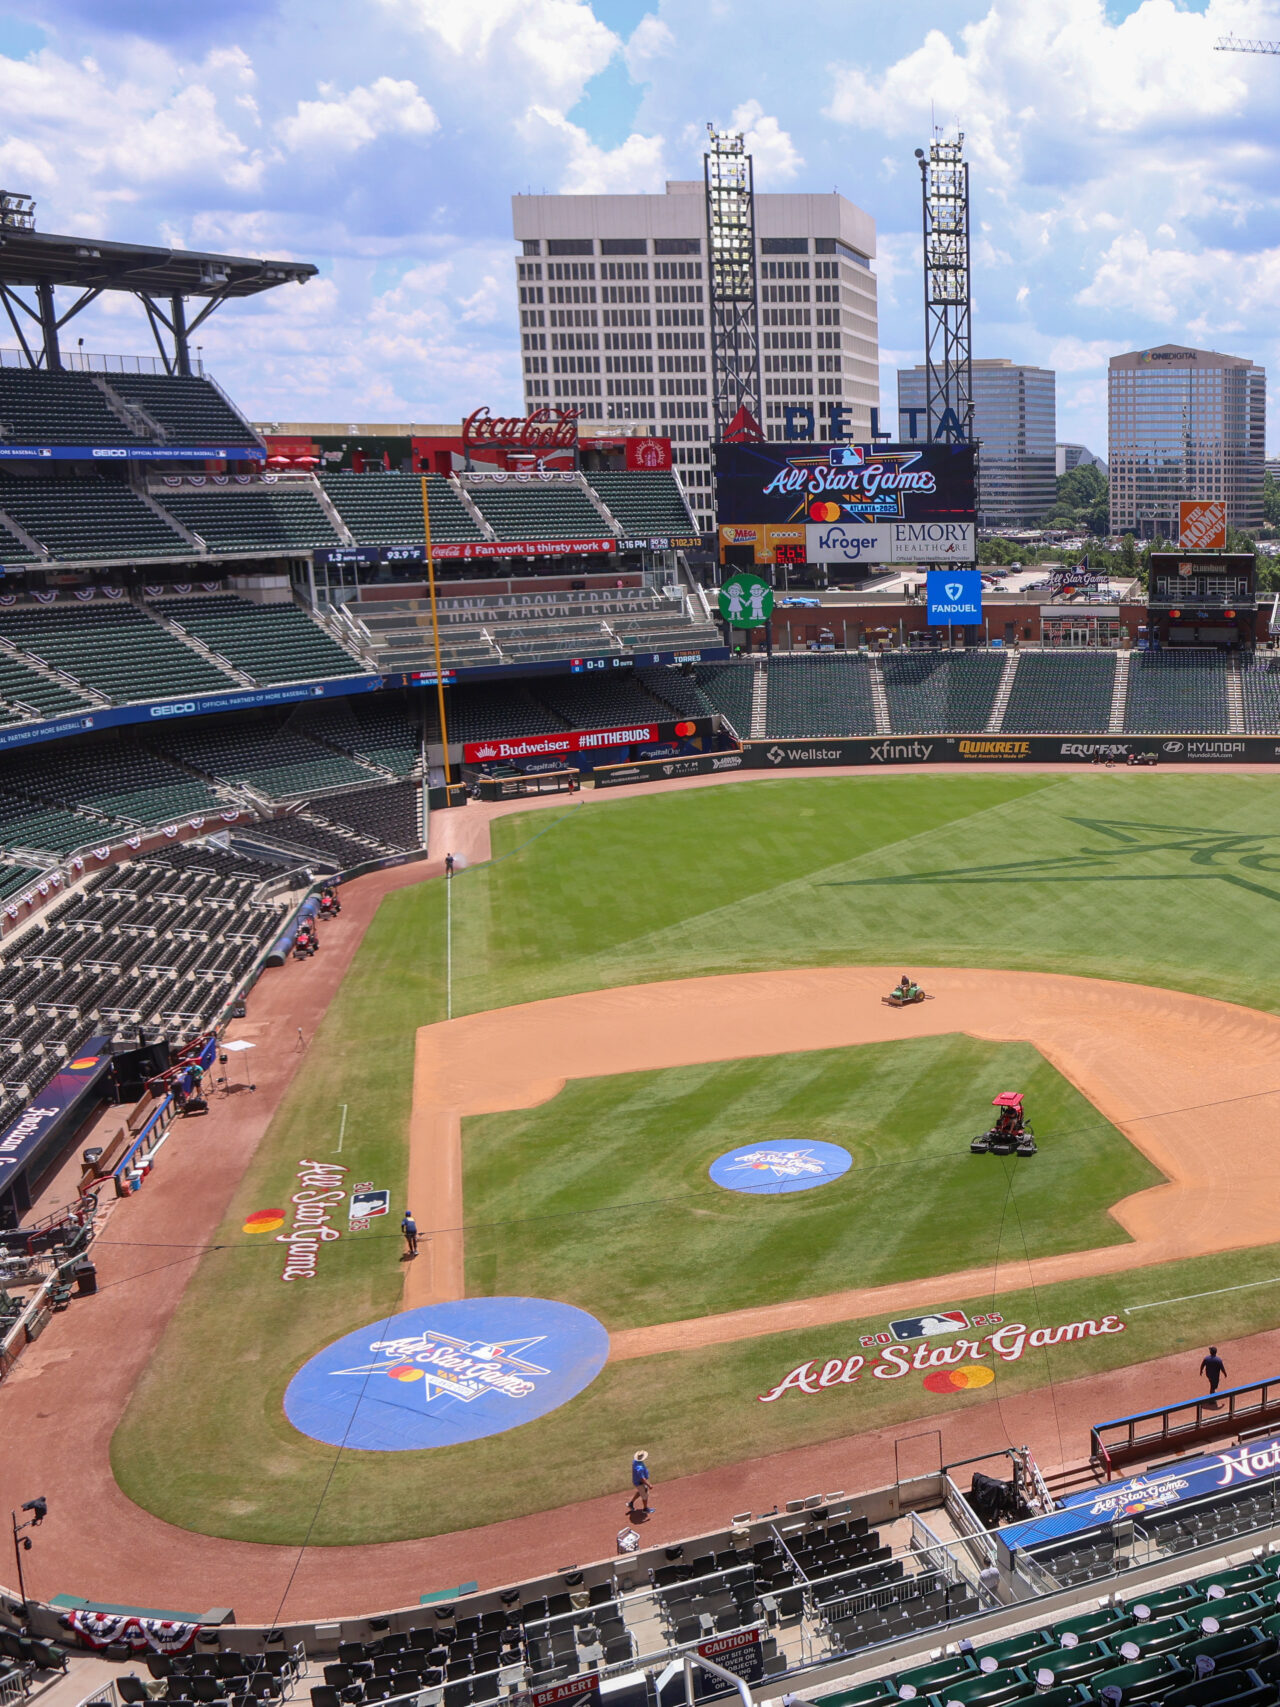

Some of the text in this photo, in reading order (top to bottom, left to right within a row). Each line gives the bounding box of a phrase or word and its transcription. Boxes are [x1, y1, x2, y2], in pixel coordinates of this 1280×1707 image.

[785, 407, 966, 439] DELTA
[763, 465, 936, 497] All Star Game
[850, 504, 897, 513] ATLANTA 2025
[1184, 507, 1203, 525] THE
[1180, 502, 1225, 548] HOME
[896, 524, 970, 541] EMORY
[1197, 520, 1225, 548] DEPOT
[475, 547, 496, 555] Fan
[497, 546, 525, 554] work
[527, 544, 535, 552] is
[537, 543, 571, 553] thirsty
[618, 540, 633, 549] 1:16
[634, 540, 647, 548] PM
[670, 539, 702, 547] $102,313
[819, 527, 878, 559] Kroger
[896, 543, 967, 552] HEALTHCARE
[387, 551, 409, 559] 93.9
[777, 545, 806, 558] 264
[1044, 572, 1109, 584] All Star Game
[438, 590, 660, 623] HANK AARON TERRACE
[932, 604, 977, 613] FANDUEL
[674, 655, 701, 663] TORRES
[151, 703, 196, 717] GEICO
[202, 700, 229, 709] OFFICIAL
[230, 697, 255, 706] PARTNER
[266, 693, 282, 701] MORE
[283, 690, 309, 700] BASEBALL
[499, 728, 650, 757] Budweiser #HITTHEBUDS
[959, 740, 1030, 754] QUIKRETE
[1188, 742, 1245, 752] HYUNDAI
[787, 749, 842, 761] Wellstar
[870, 741, 933, 762] xfinity
[1060, 743, 1129, 756] EQUIFAX
[353, 1182, 374, 1194] 20
[274, 1159, 350, 1281] All Star Game
[349, 1219, 371, 1232] 25
[860, 1312, 1004, 1348] 20 25
[757, 1314, 1126, 1402] All Star Game
[705, 1633, 753, 1654] CAUTION
[716, 1654, 729, 1662] NOT
[731, 1650, 741, 1658] SIT
[725, 1657, 743, 1666] OVER
[728, 1660, 758, 1671] OBJECTS
[537, 1679, 593, 1704] BE ALERT
